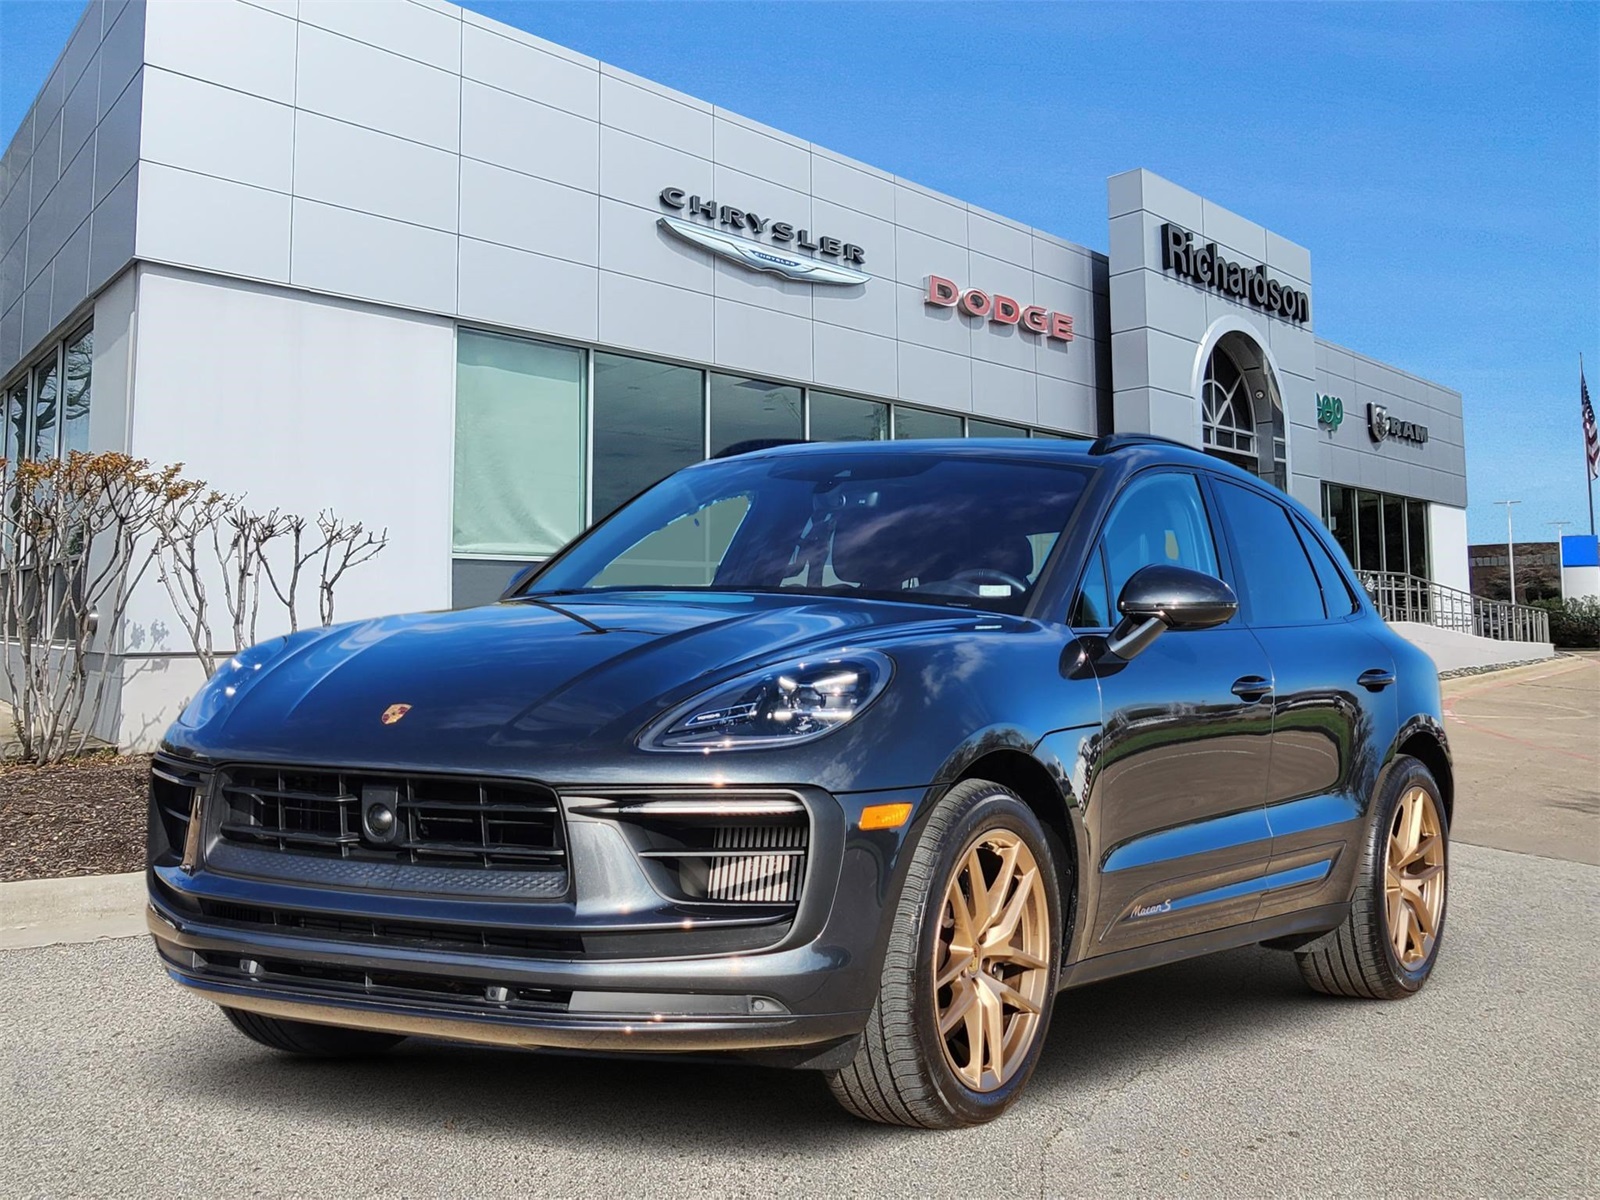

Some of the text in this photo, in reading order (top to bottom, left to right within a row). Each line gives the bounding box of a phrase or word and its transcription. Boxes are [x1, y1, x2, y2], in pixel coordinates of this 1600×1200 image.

[659, 187, 866, 264] CHRYSLER
[1161, 223, 1309, 322] Richardson
[923, 275, 1074, 342] DODGE
[1388, 416, 1428, 443] RAM
[1130, 899, 1171, 918] Macan S
